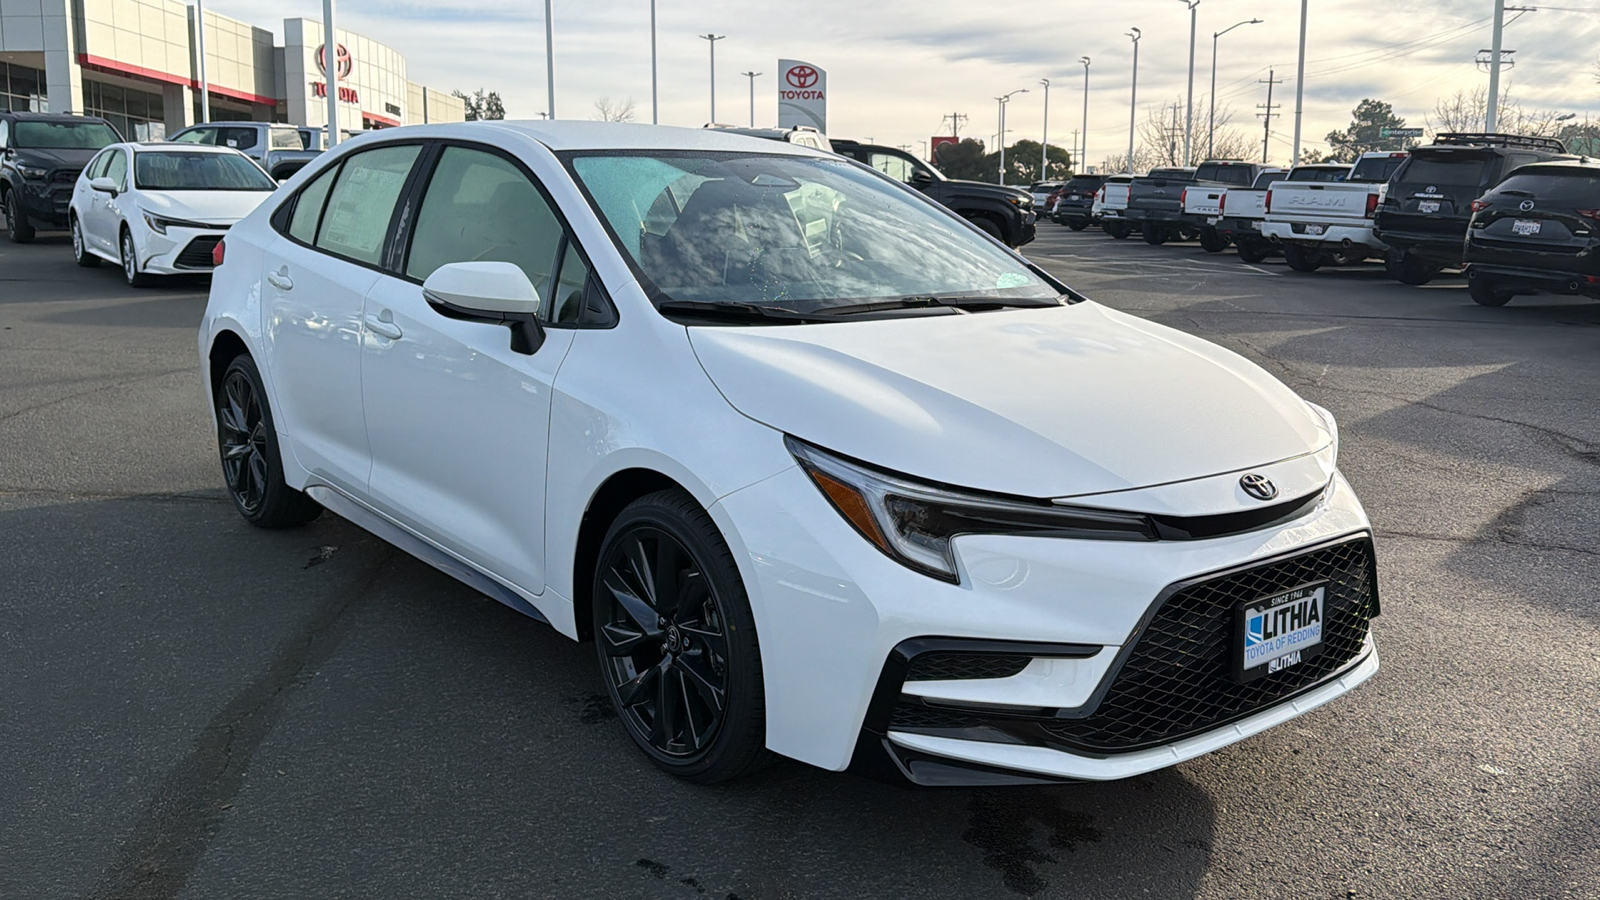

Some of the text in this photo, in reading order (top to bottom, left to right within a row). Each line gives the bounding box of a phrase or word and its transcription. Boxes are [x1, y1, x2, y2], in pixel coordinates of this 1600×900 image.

[311, 81, 359, 104] TOOTA
[780, 90, 825, 100] TOYOTA
[1288, 196, 1346, 207] RAM
[1270, 590, 1304, 607] SINCE 1946
[1263, 598, 1320, 641] LITHIA
[1246, 625, 1320, 661] TOYOTA OF REDDING
[1276, 650, 1302, 671] LITHIA
